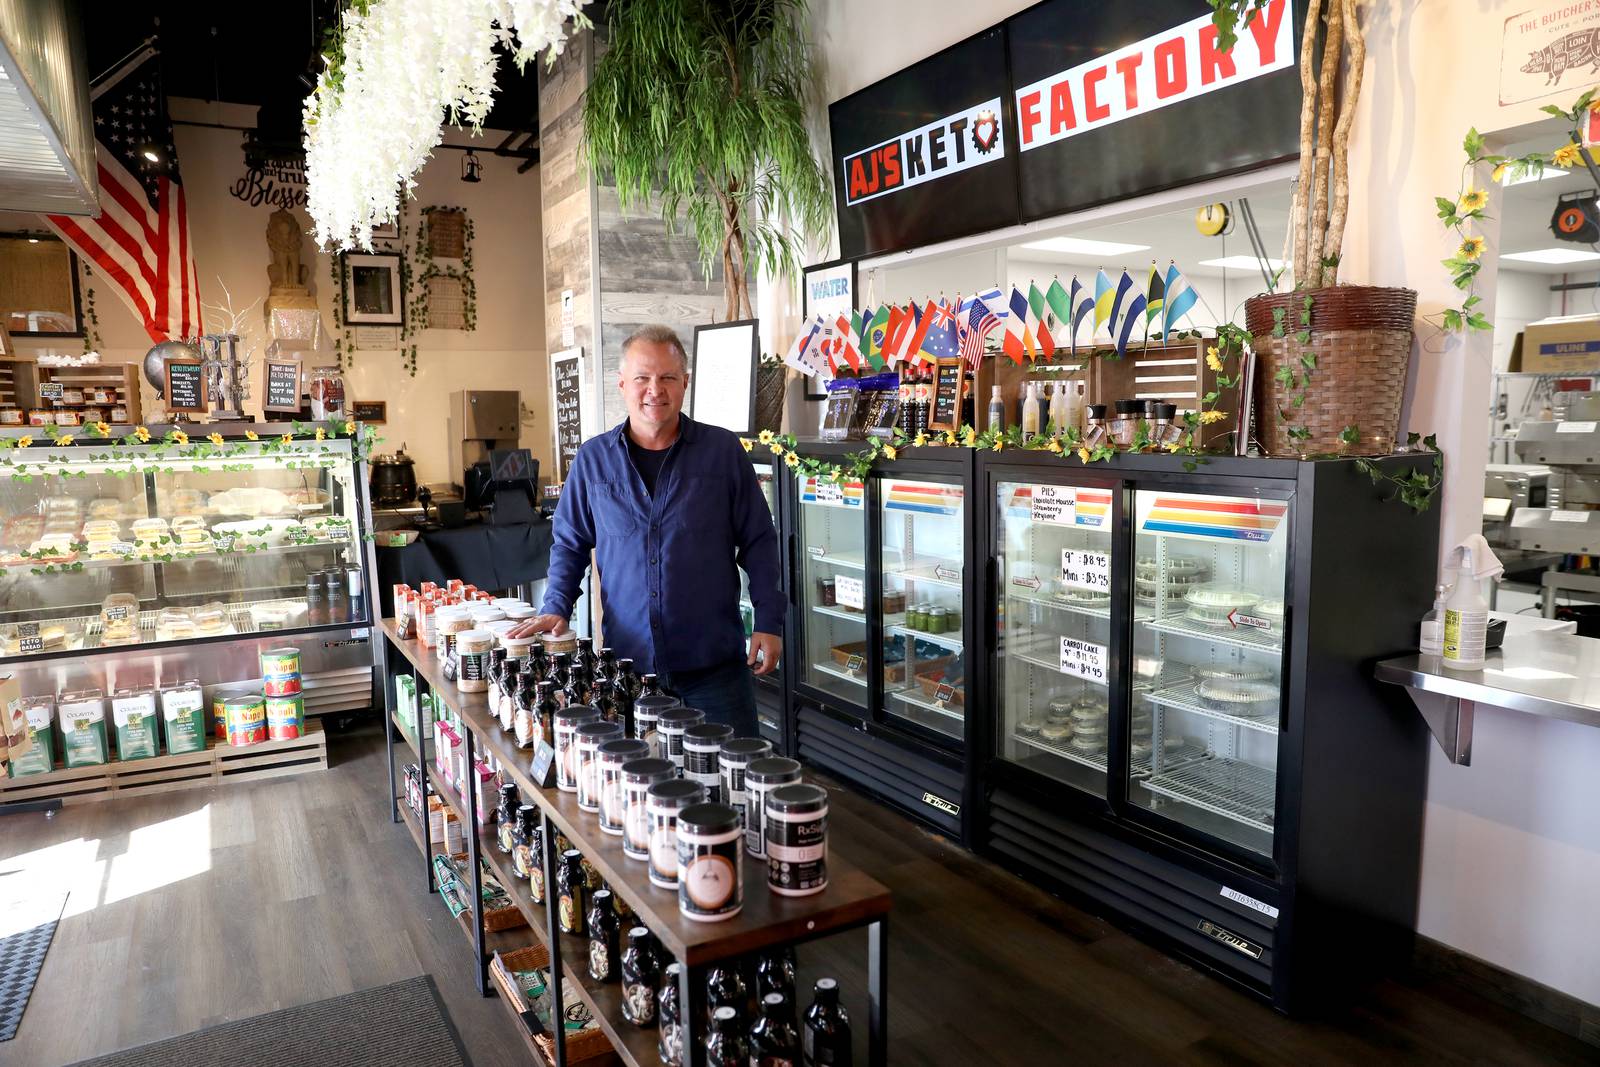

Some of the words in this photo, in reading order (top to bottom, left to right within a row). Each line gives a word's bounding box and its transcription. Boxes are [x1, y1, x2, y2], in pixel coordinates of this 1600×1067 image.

[1520, 20, 1538, 34] THE
[1568, 35, 1588, 48] LOIN
[1019, 0, 1287, 145] FACTORY
[850, 143, 900, 199] AJ'S
[230, 167, 307, 209] Blesse
[811, 276, 849, 301] WATER
[1556, 343, 1586, 354] ULINE
[1055, 498, 1075, 507] Mousse
[1062, 568, 1079, 582] Mini
[1255, 618, 1267, 628] Open
[21, 638, 40, 646] KETO
[1084, 644, 1099, 655] CAKE
[275, 660, 297, 673] Napoli
[1062, 660, 1076, 669] Mini
[66, 710, 95, 720] COLAVITA
[1216, 930, 1248, 949] true
